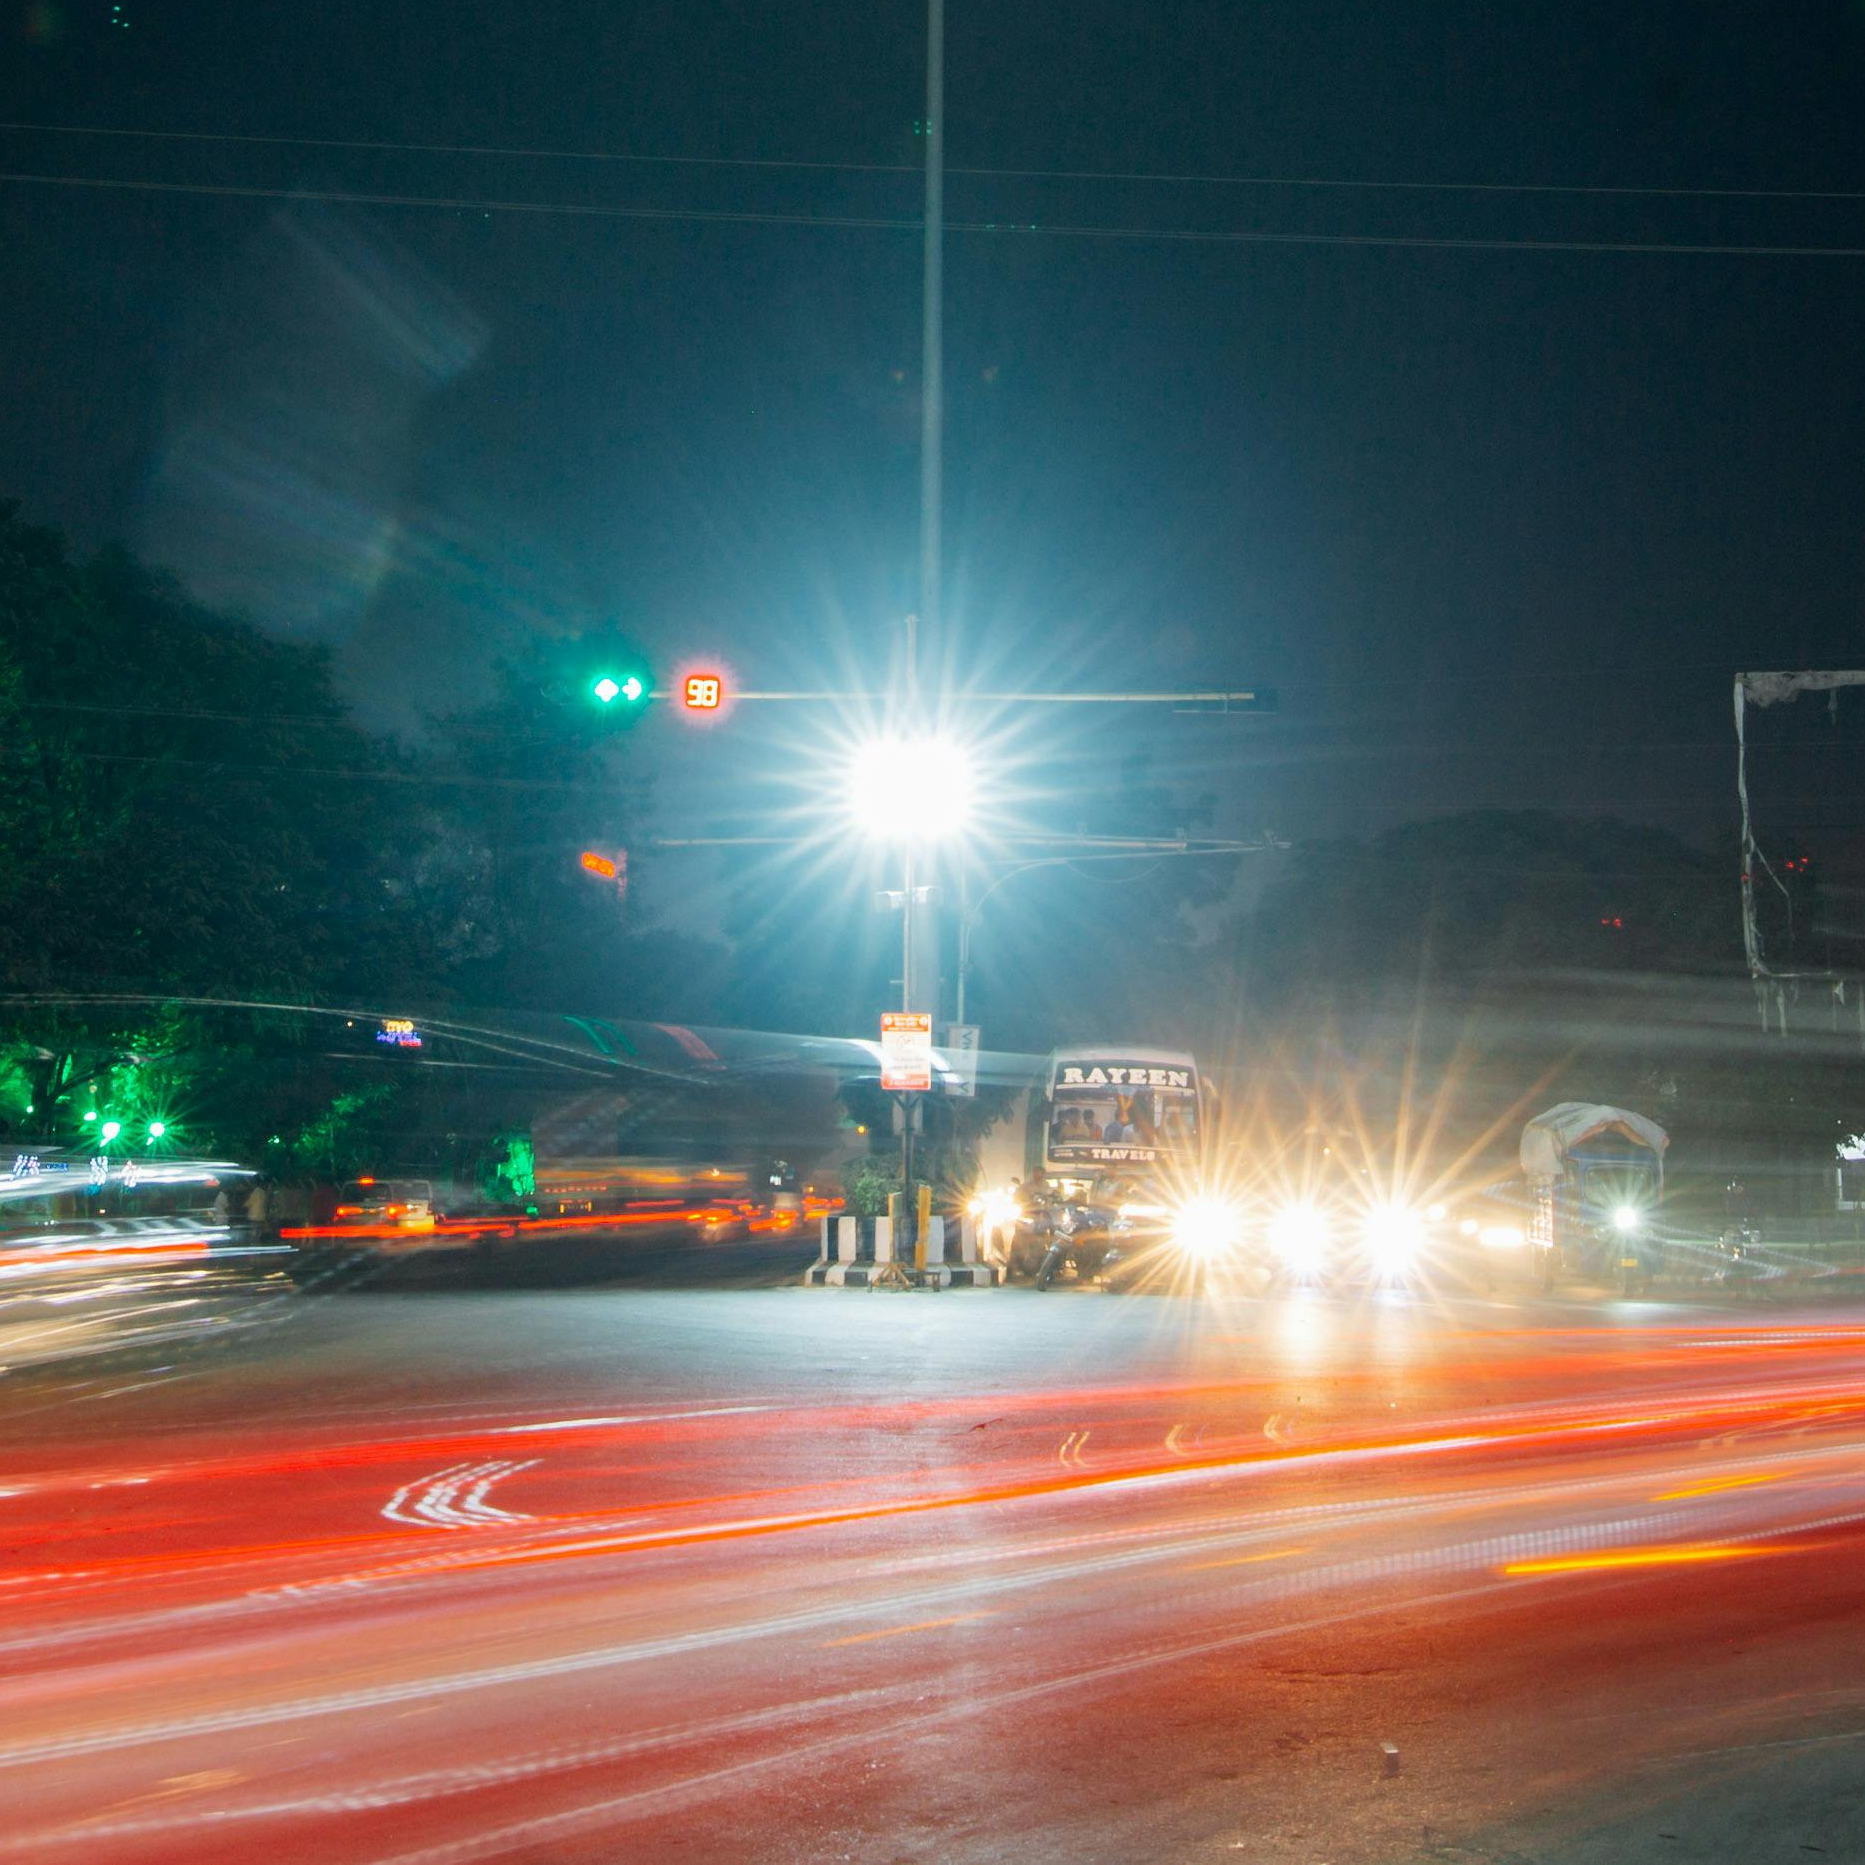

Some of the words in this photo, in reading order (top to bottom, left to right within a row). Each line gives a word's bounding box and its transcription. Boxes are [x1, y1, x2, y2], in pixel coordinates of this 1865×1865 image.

[686, 678, 719, 708] 98
[1063, 1067, 1189, 1088] RAYEEN
[1091, 1148, 1156, 1161] TRAVELS
